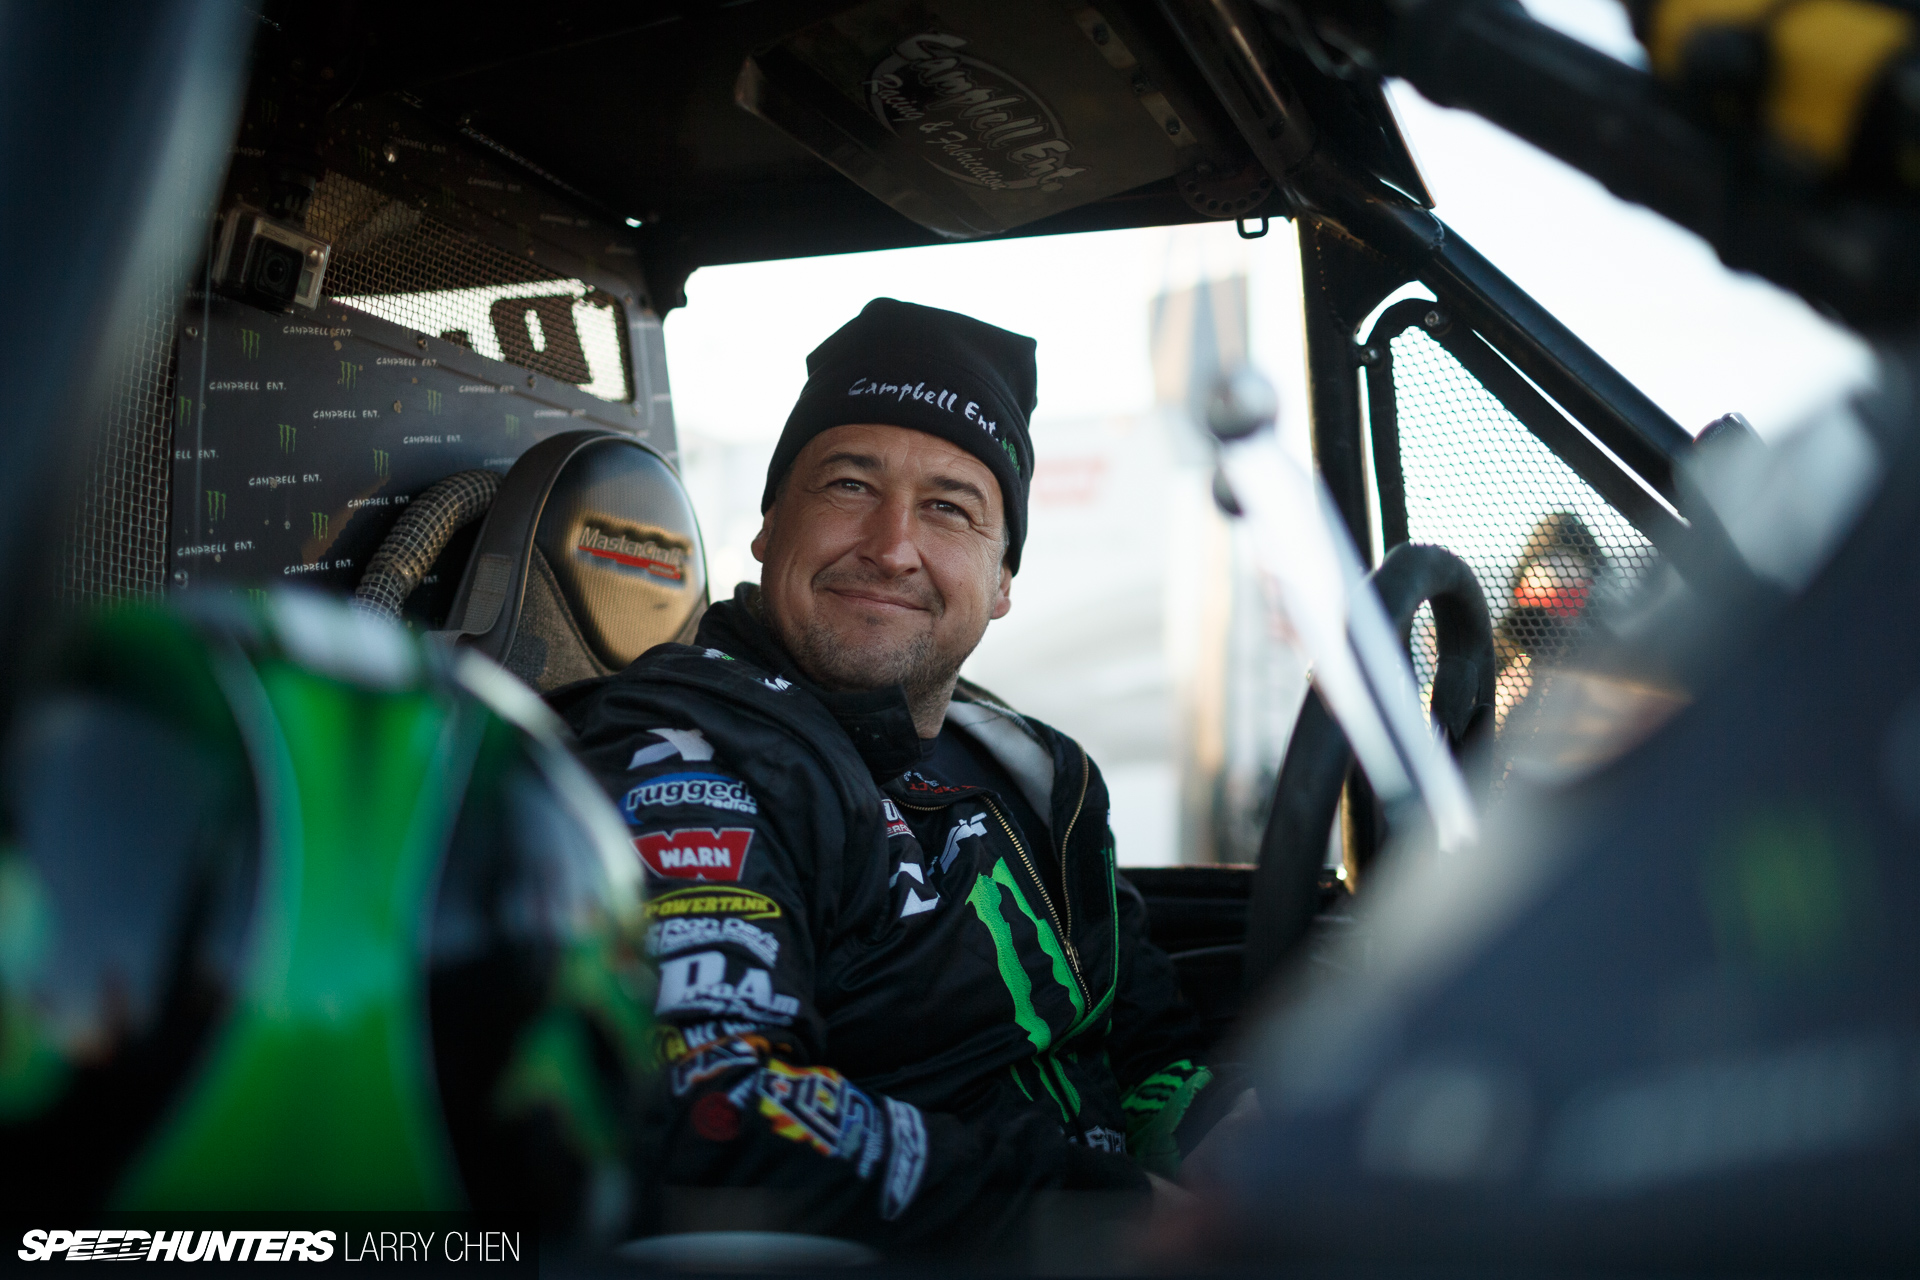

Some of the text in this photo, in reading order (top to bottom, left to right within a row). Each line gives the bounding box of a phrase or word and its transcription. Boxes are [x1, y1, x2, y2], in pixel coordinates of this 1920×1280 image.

[895, 33, 1044, 148] Campbell
[861, 74, 925, 122] Racing
[919, 121, 953, 134] &
[283, 325, 329, 336] CAMPBELL
[376, 357, 416, 367] CAMPBELL
[209, 381, 287, 391] CAMPBELL ENT.
[848, 377, 958, 413] Campbell
[312, 410, 357, 419] CAMPBELL
[403, 435, 442, 444] CAMPBELL
[303, 474, 322, 483] ENT.
[348, 497, 389, 507] CAMPBELL
[177, 541, 256, 556] CAMPBELL ENT.
[284, 562, 330, 574] CAMPBELL
[626, 781, 748, 811] rugged
[704, 799, 757, 814] radios
[658, 846, 731, 868] WARN
